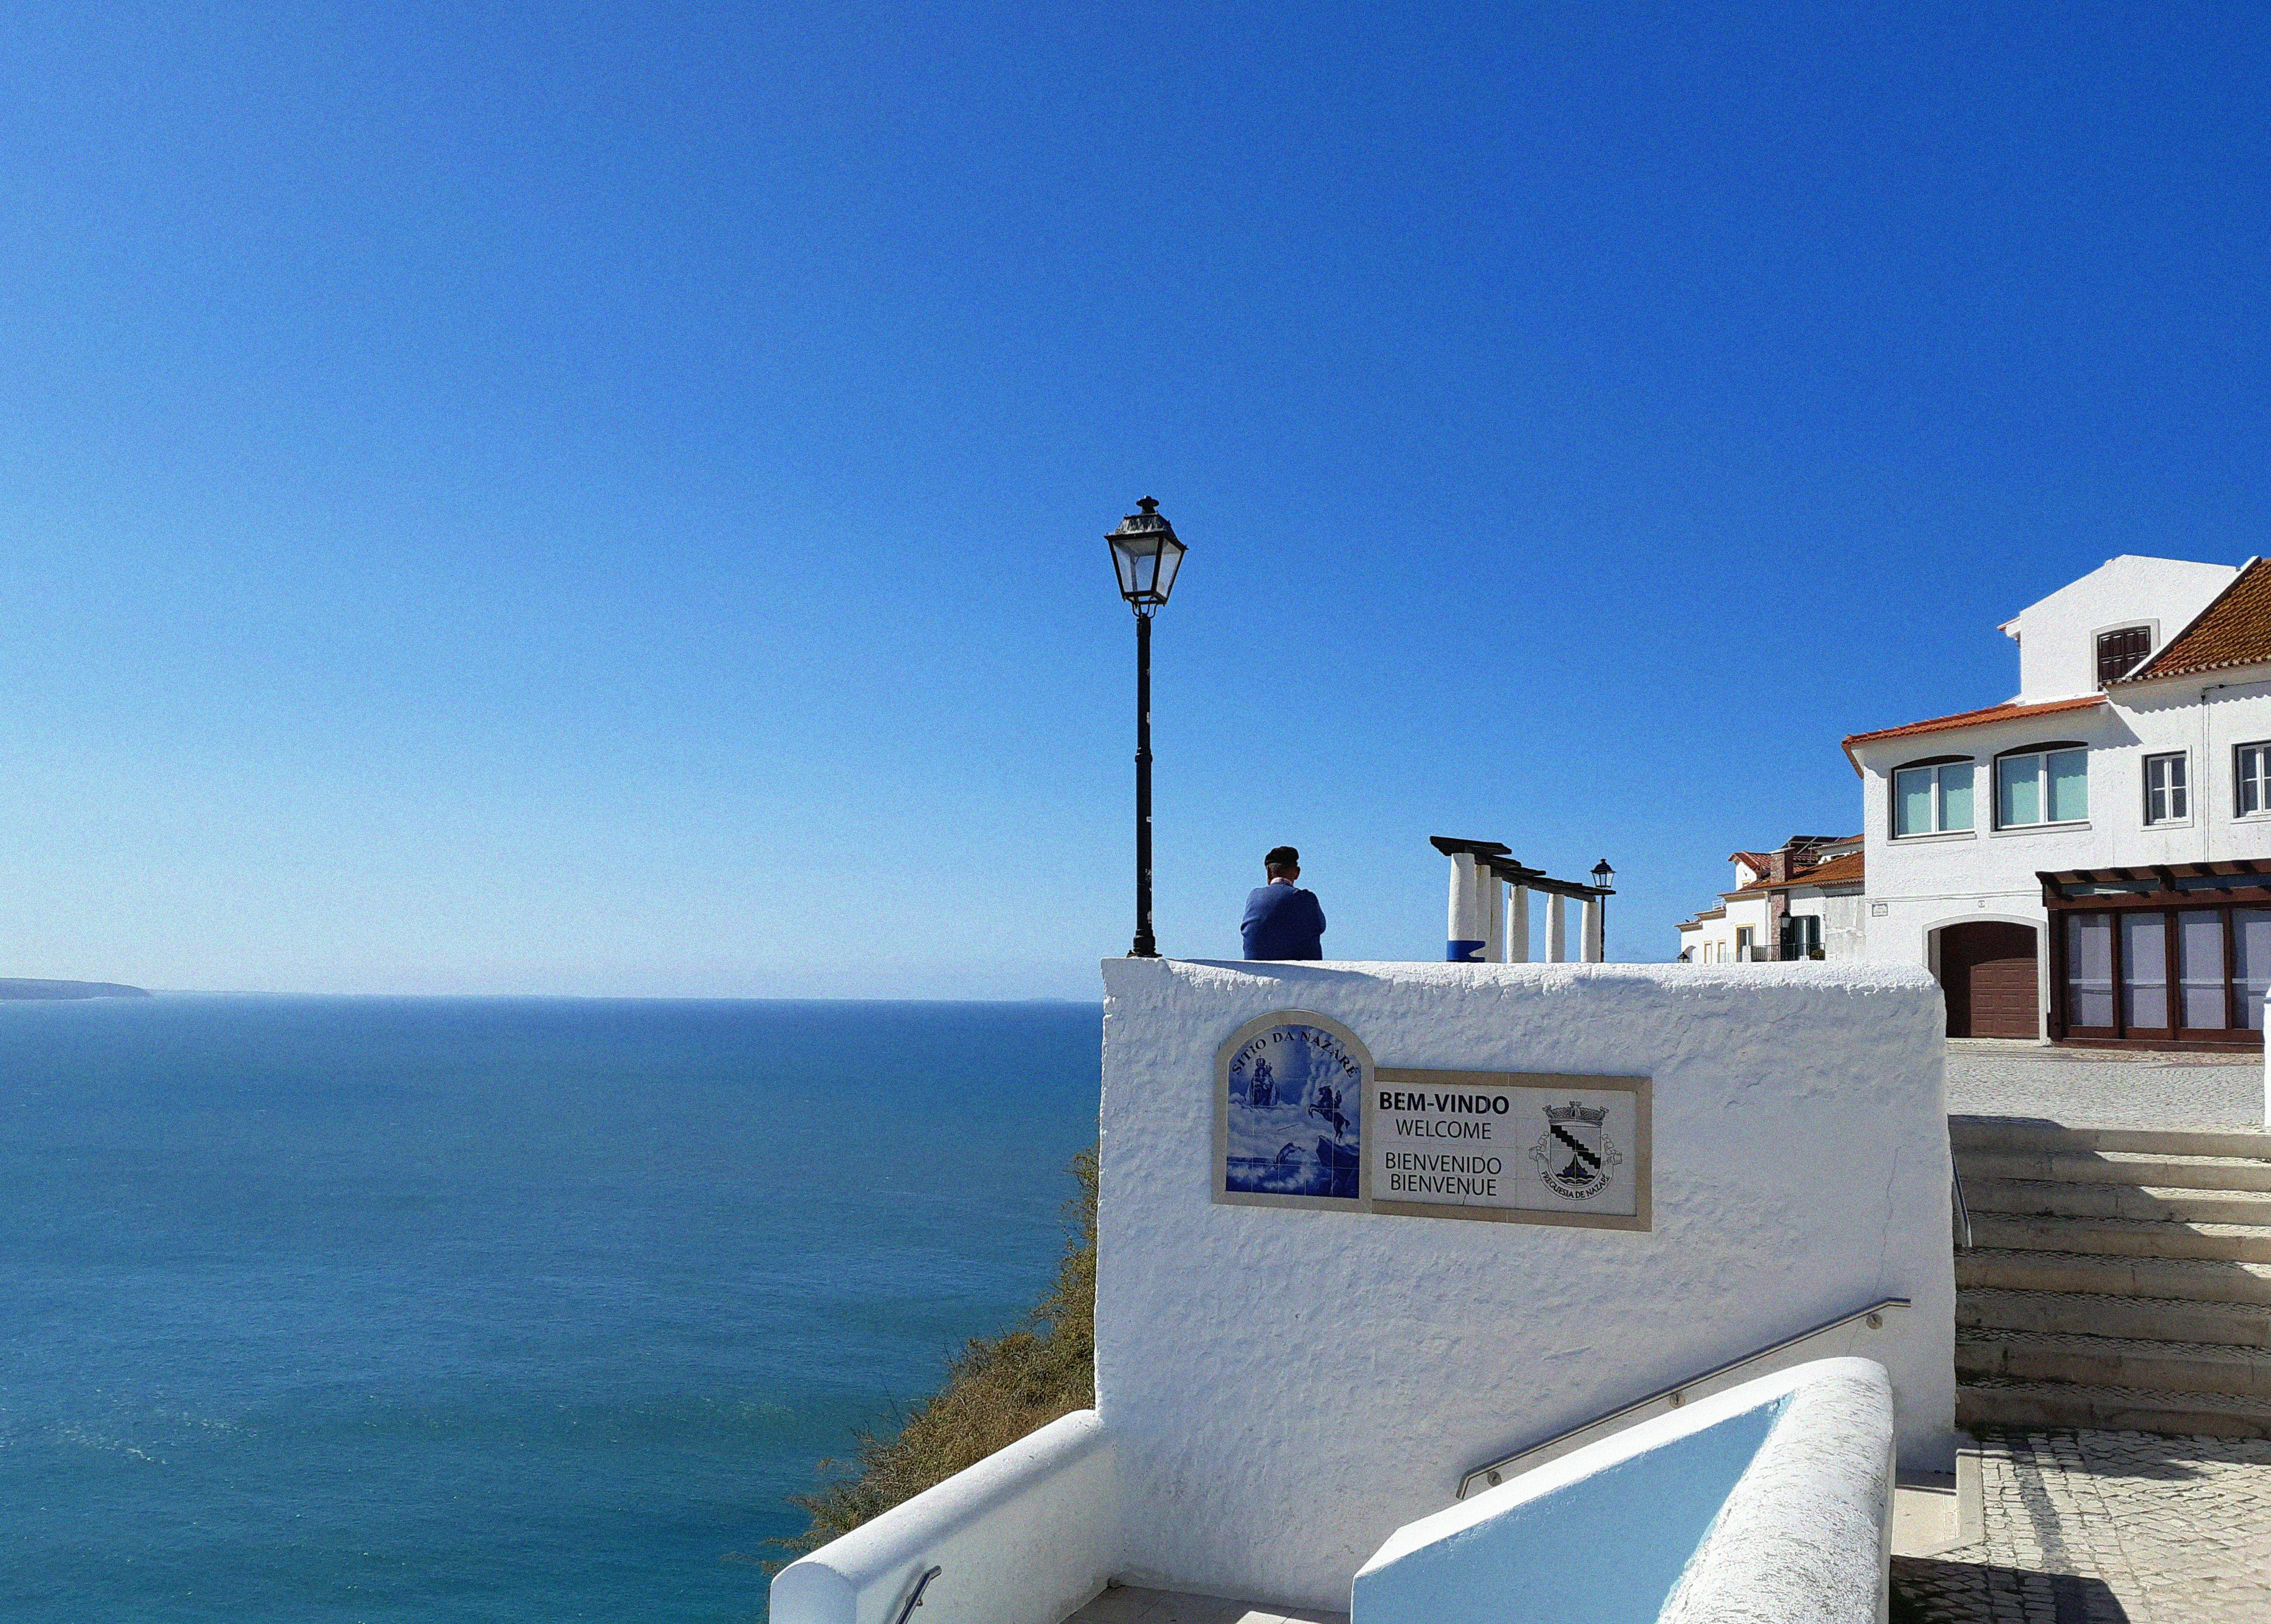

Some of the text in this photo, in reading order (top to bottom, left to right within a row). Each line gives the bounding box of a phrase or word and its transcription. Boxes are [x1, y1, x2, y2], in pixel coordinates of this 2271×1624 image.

[1232, 1038, 1266, 1075] SITIO
[1273, 1031, 1294, 1043] DA
[1379, 1091, 1510, 1114] BEM-VINDO
[1396, 1118, 1491, 1139] WELCOME
[1385, 1152, 1502, 1175] BIENVENIDO
[1391, 1173, 1497, 1196] BIENVENUE
[1542, 1170, 1574, 1198] FREGUESIA
